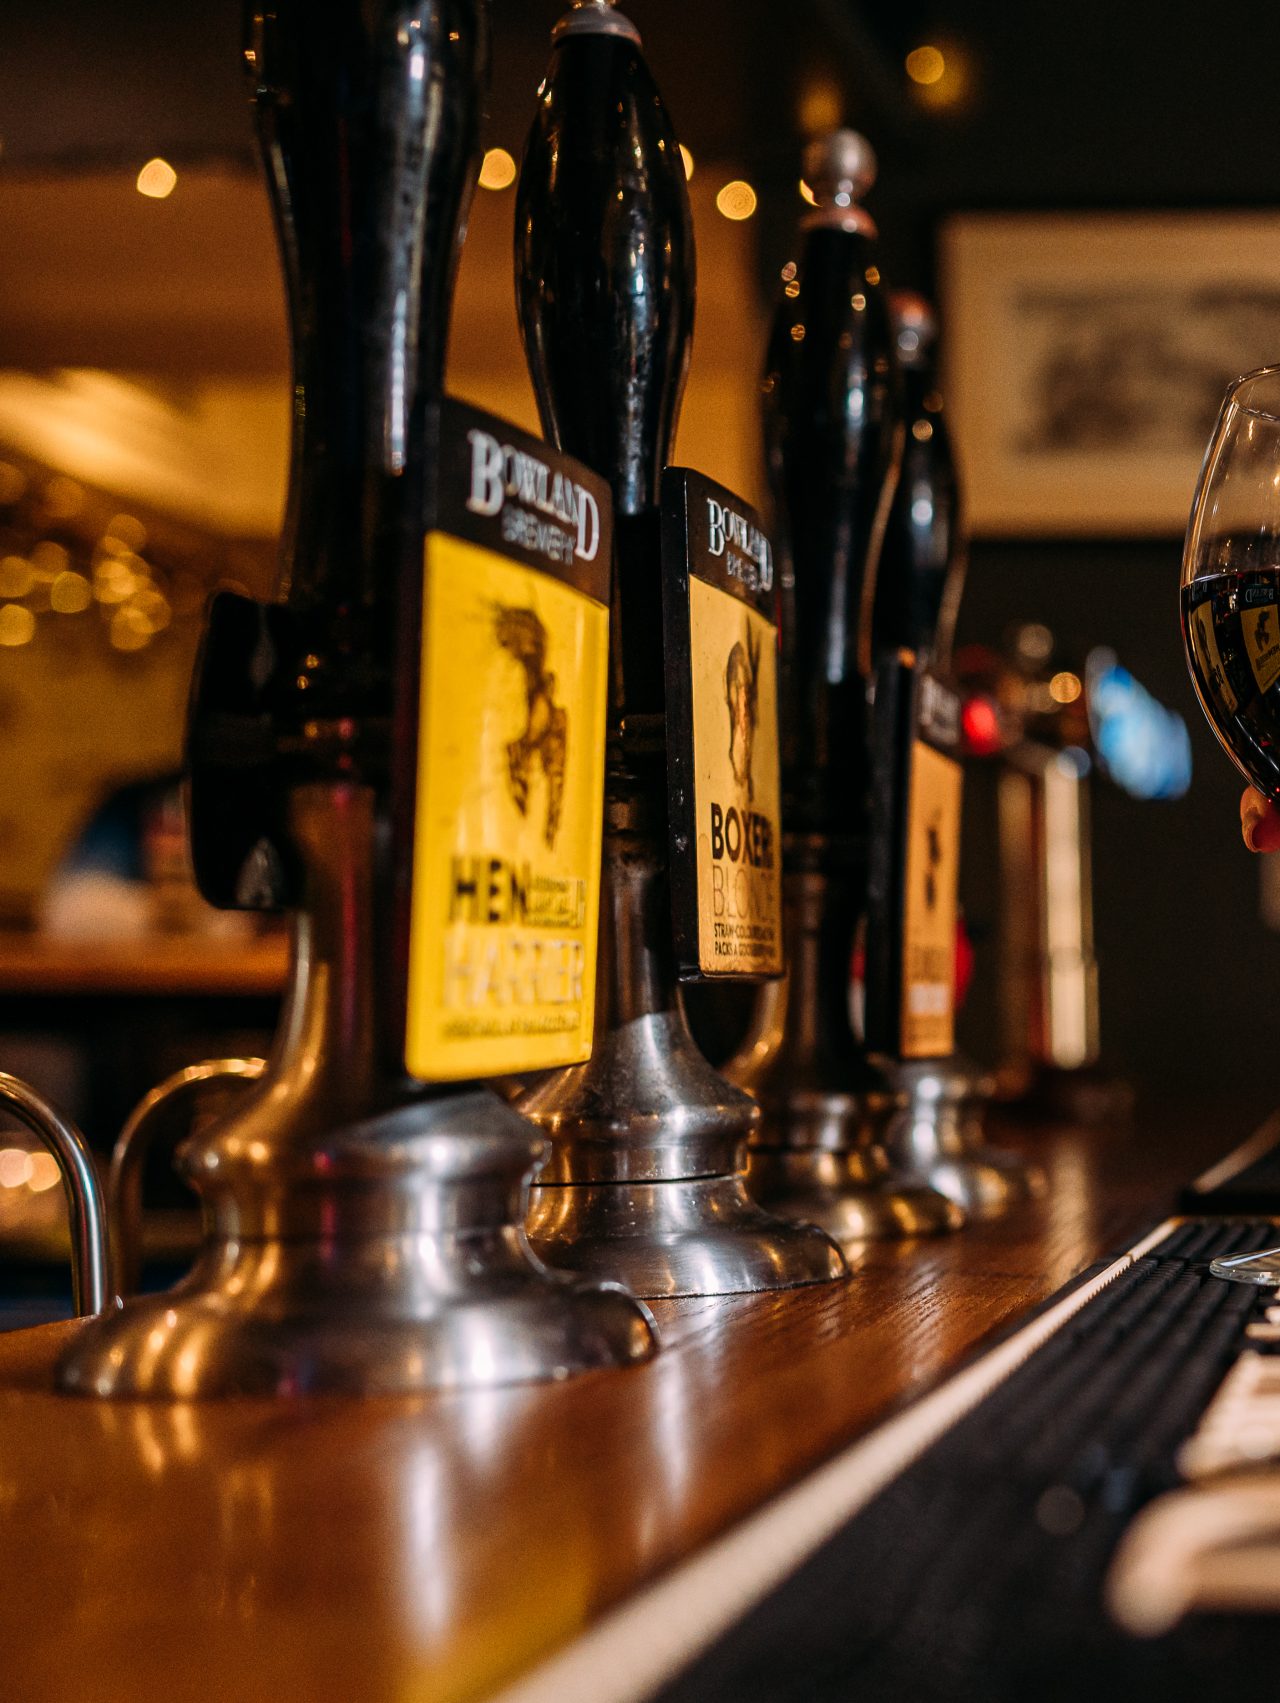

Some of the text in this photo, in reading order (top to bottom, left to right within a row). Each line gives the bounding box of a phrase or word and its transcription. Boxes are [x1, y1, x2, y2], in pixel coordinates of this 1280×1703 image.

[466, 429, 600, 561] BOWLAND
[706, 498, 774, 592] BOWLAND
[711, 803, 774, 870] BOXER
[450, 855, 531, 928] HEN
